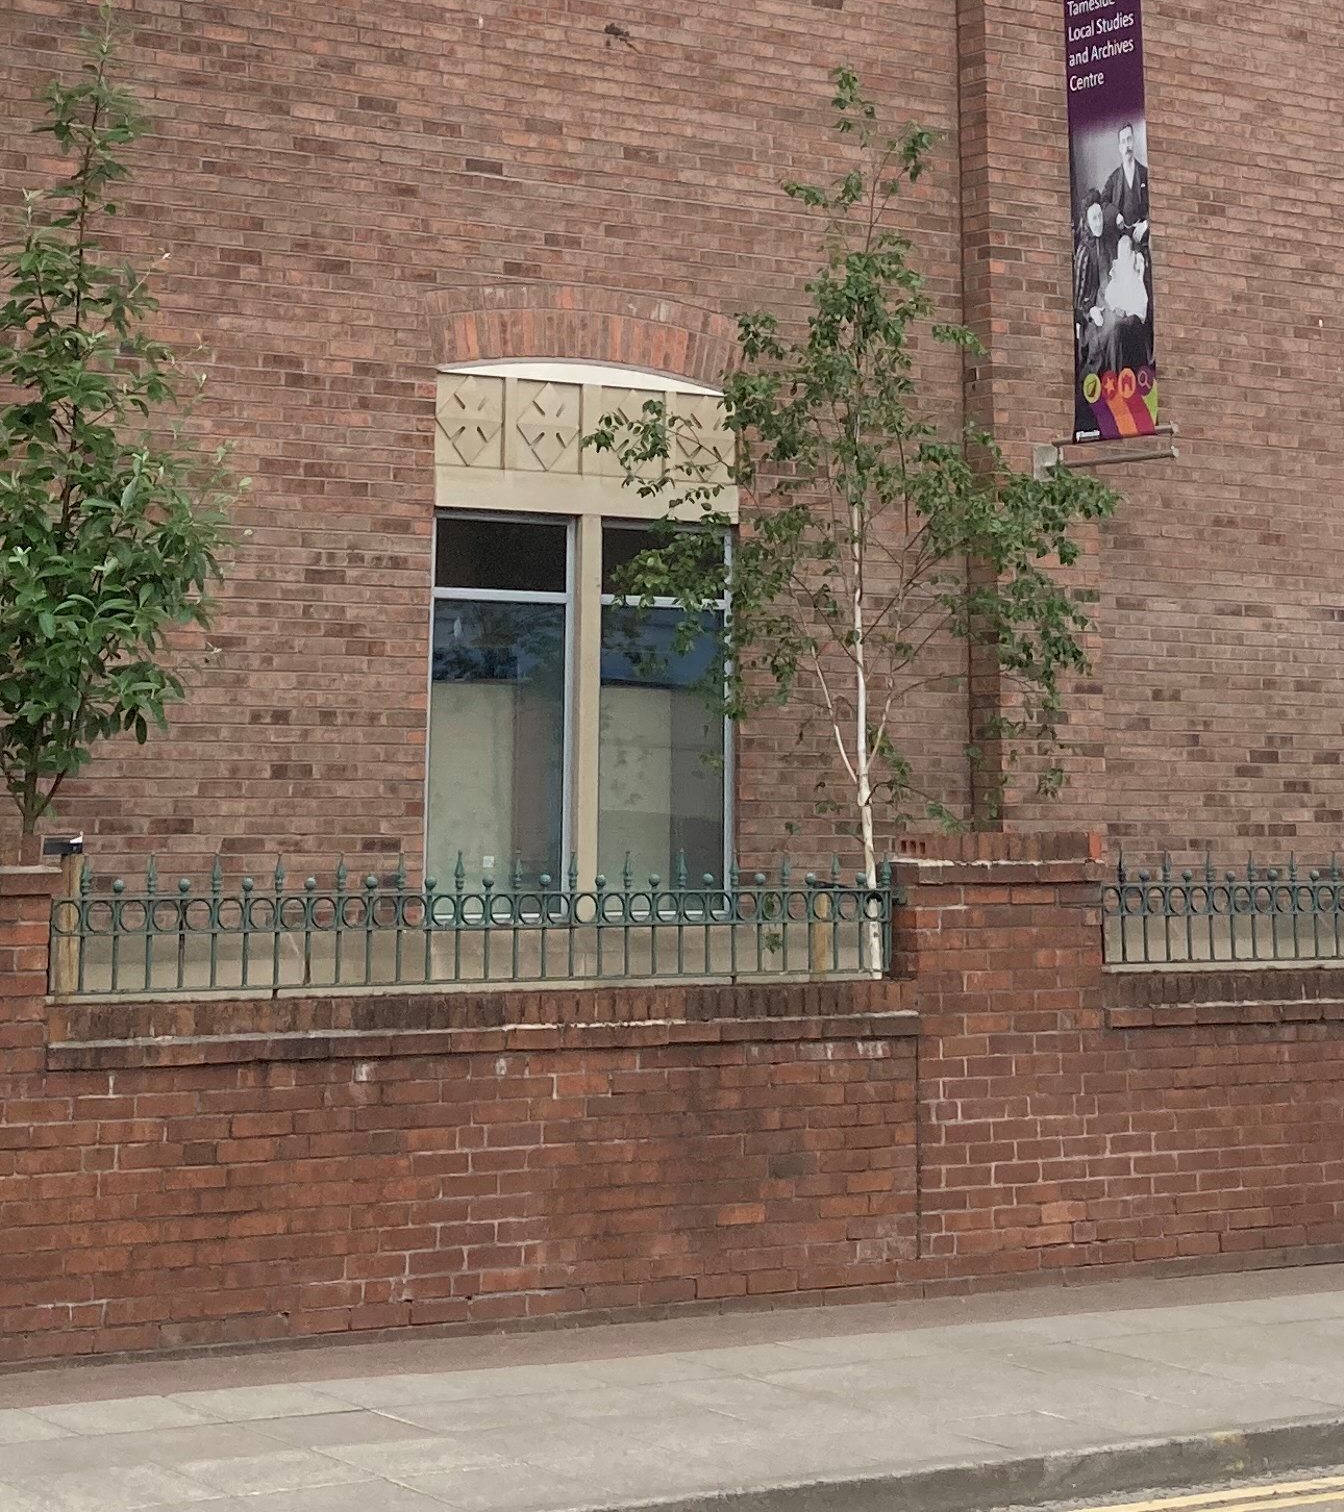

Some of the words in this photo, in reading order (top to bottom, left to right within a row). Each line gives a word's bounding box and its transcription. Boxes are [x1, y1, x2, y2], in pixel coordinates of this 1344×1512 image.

[1068, 20, 1094, 41] Local
[1096, 12, 1134, 34] Studies
[1069, 47, 1089, 67] and
[1091, 39, 1134, 61] Archives
[1069, 72, 1104, 91] Centre
